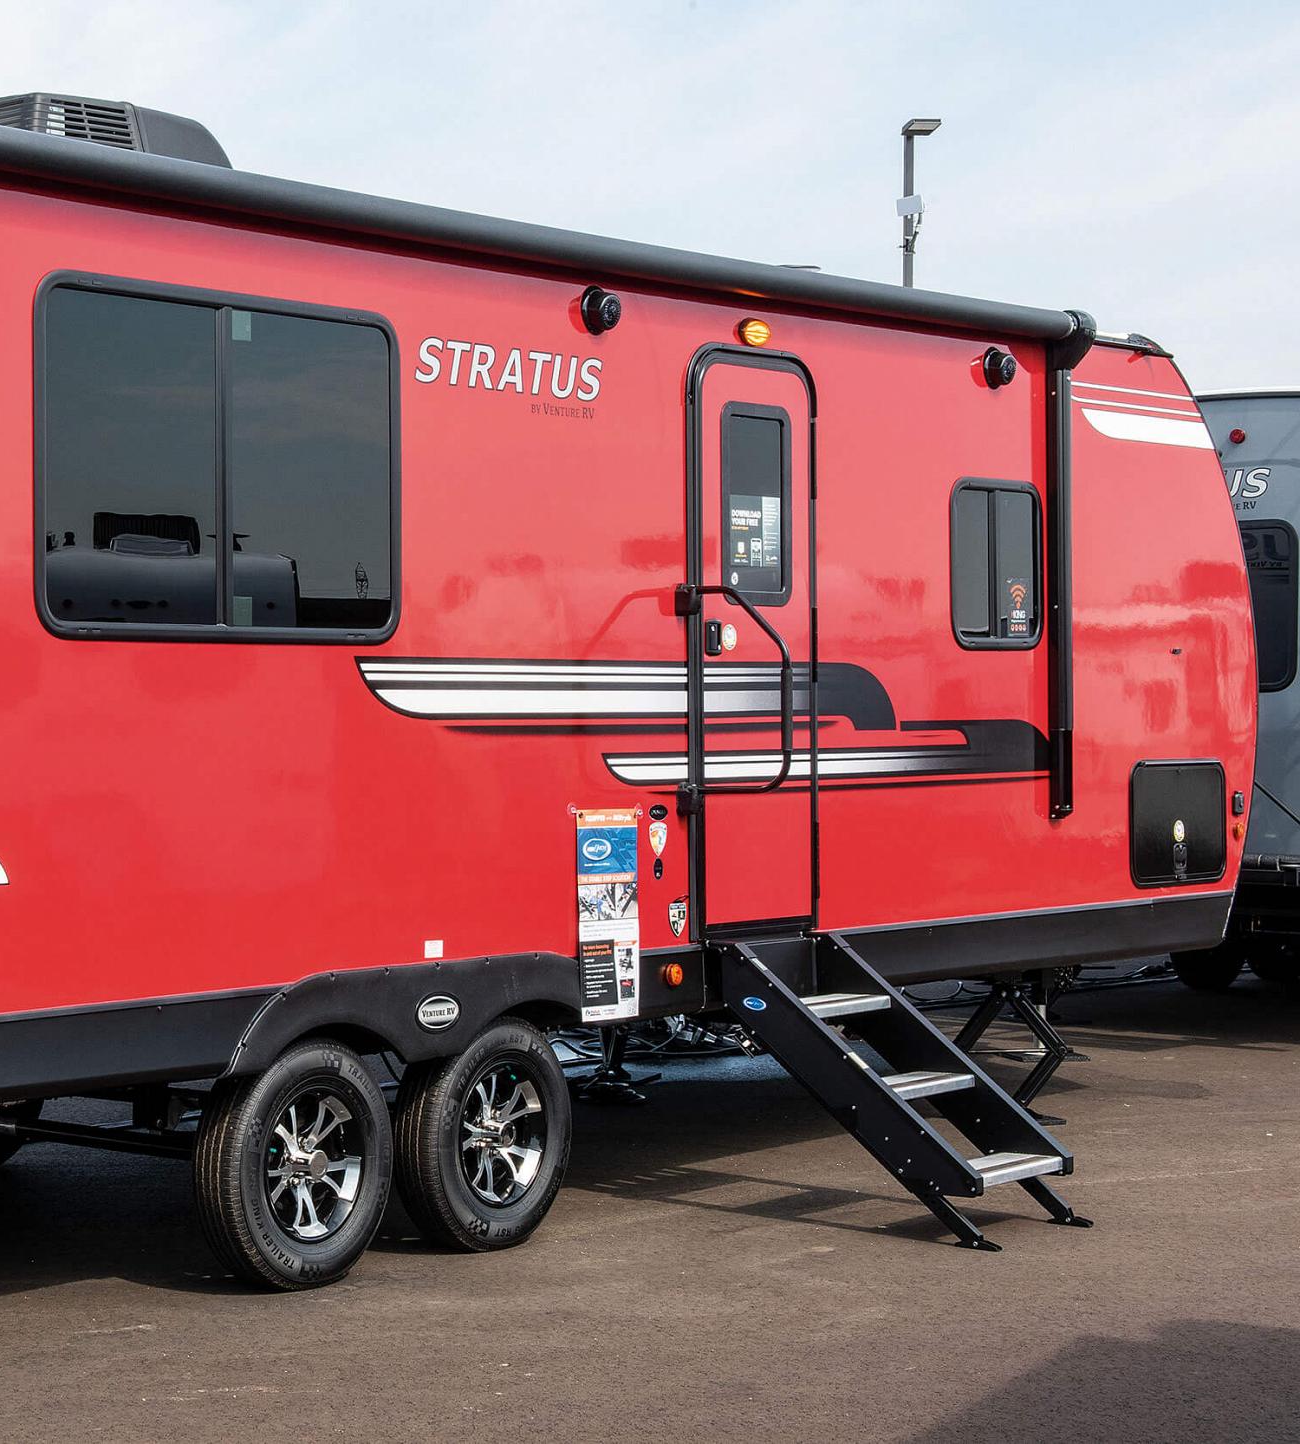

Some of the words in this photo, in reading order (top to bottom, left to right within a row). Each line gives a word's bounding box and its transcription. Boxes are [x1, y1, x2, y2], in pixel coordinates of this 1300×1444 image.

[413, 336, 604, 402] STRATUS
[531, 404, 542, 415] BY
[543, 403, 580, 418] VENTURE
[582, 407, 595, 419] RV
[1243, 501, 1257, 510] RV
[731, 509, 762, 519] DOWNLOAD
[746, 518, 759, 527] FREE
[447, 1007, 455, 1016] RV
[262, 1232, 296, 1271] TRAILER
